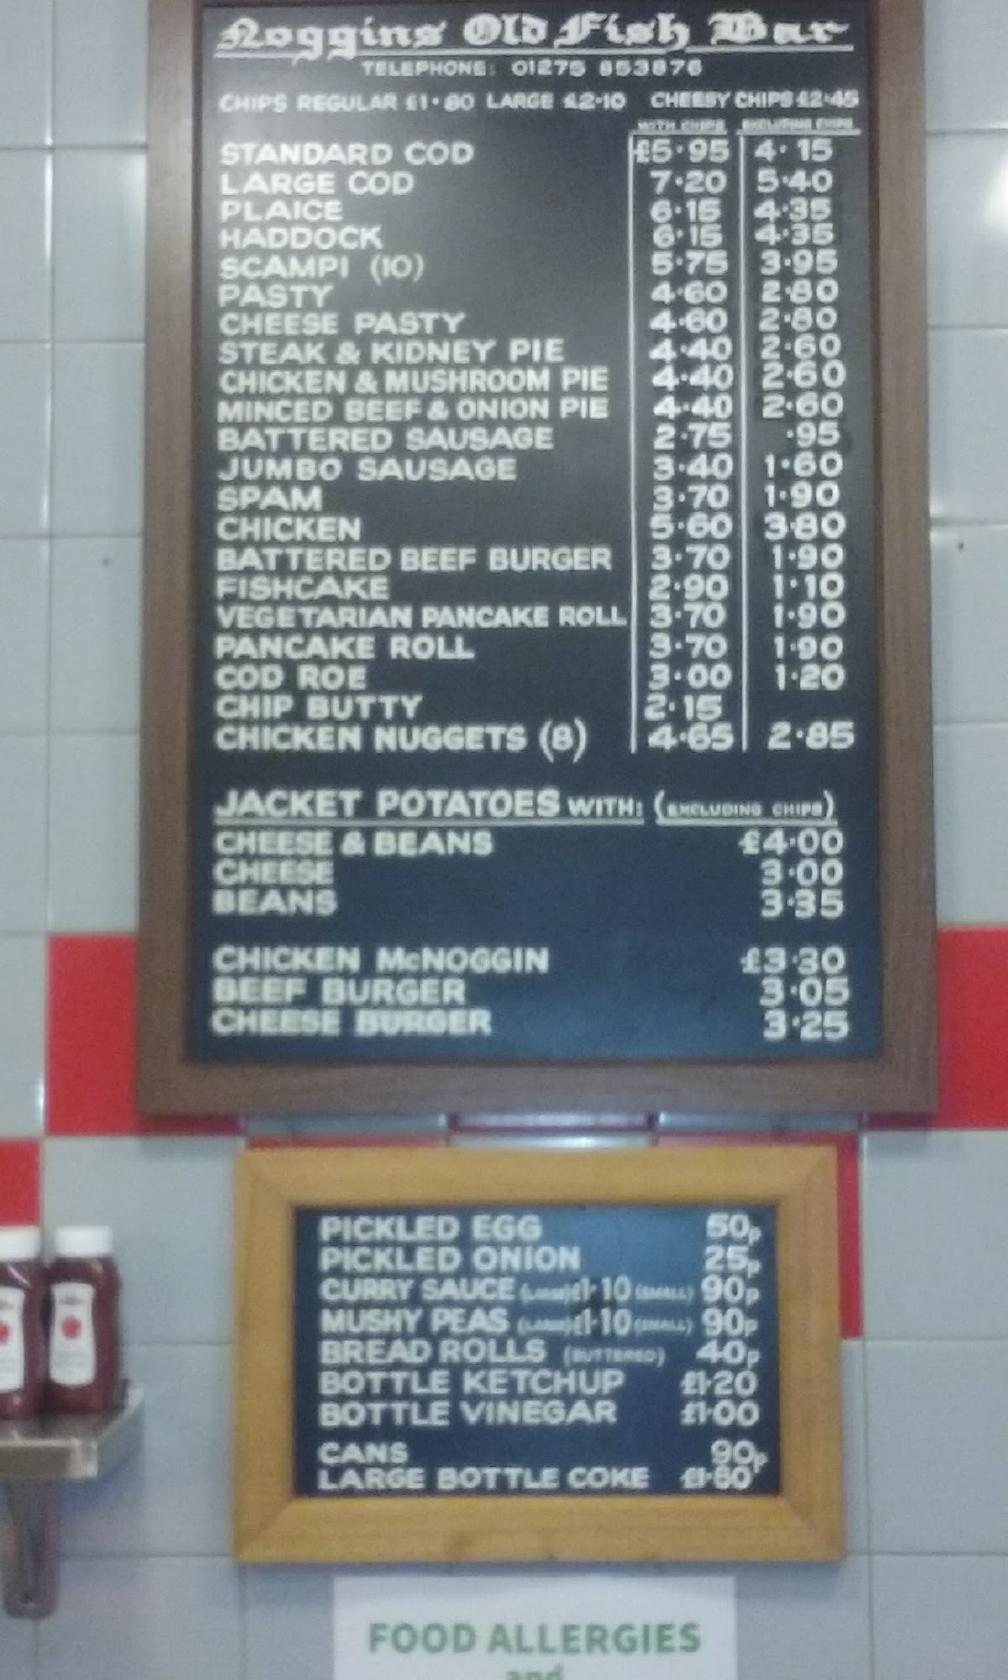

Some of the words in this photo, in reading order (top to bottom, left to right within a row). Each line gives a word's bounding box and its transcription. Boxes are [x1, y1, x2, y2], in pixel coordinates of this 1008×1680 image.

[216, 18, 447, 66] Noggins
[463, 14, 548, 45] Old
[554, 12, 690, 50] Fish
[709, 12, 848, 44] Bar
[219, 94, 287, 112] CHIPS
[296, 93, 397, 112] REGULAR
[487, 92, 553, 109] LARGE
[651, 91, 731, 108] CHEESY
[734, 91, 793, 108] CHIPS
[220, 141, 392, 165] STANDARD
[404, 141, 474, 165] COD
[221, 172, 334, 195] LARGE
[348, 170, 413, 195] COD
[221, 199, 342, 221] PLAICE
[220, 225, 382, 249] HADDOCK
[221, 255, 348, 279] SCAMPI
[370, 253, 425, 284] (10)
[219, 283, 333, 308] PASTY
[220, 312, 338, 335] CHEESE
[355, 312, 465, 334] PASTY
[219, 341, 325, 364] STEAK
[336, 341, 360, 364] &
[371, 340, 496, 363] KIDNEY
[510, 339, 563, 362] PIE
[220, 370, 346, 393] CHICKEN
[355, 370, 377, 394] &
[385, 369, 550, 392] MUSHROOM
[562, 367, 607, 391] PIE
[218, 399, 333, 422] MINCED
[345, 399, 421, 422] BEEF
[427, 400, 449, 420] &
[457, 398, 549, 419] ONION
[560, 397, 608, 419] PIE
[218, 427, 392, 452] BATTERED
[406, 427, 553, 450] SAUSAGE
[219, 458, 342, 480] JUMBO
[358, 457, 516, 481] SAUSAGE
[218, 486, 322, 511] SPAM
[218, 516, 360, 541] CHICKEN
[217, 547, 391, 571] BATTERED
[401, 548, 476, 571] BEEF
[489, 547, 611, 571] BURGER
[217, 576, 388, 600] FISHCAKE
[217, 606, 412, 628] VEGETARIAN
[422, 606, 548, 628] PANCAKE
[559, 606, 627, 626] ROLL
[216, 635, 374, 659] PANCAKE
[390, 634, 475, 659] ROLL
[216, 664, 284, 690] COD
[298, 664, 366, 690] ROE
[216, 694, 293, 719] CHIP
[307, 695, 422, 719] BUTTY
[217, 725, 361, 750] CHICKEN
[375, 726, 527, 751] NUGGETS
[538, 717, 589, 764] (8)
[216, 790, 361, 817] JACKET
[378, 790, 560, 817] POTATOES
[216, 831, 332, 855] CHEESE
[341, 831, 365, 855] &
[374, 830, 493, 856] BEANS
[214, 859, 333, 885] CHEESE
[213, 889, 337, 915] BEANS
[214, 947, 360, 972] CHICKEN
[377, 947, 548, 973] McNOGGIN
[214, 977, 306, 1004] BEEF
[322, 978, 465, 1005] BURGER
[212, 1008, 340, 1035] CHEESE
[356, 1009, 491, 1035] BURGER
[321, 1216, 460, 1242] PICKLED
[472, 1215, 542, 1242] EGG
[321, 1247, 462, 1272] PICKLED
[473, 1246, 580, 1271] ONION
[321, 1278, 414, 1301] CURRY
[422, 1277, 515, 1300] SAUCE
[322, 1309, 422, 1333] MUSHY
[432, 1307, 509, 1334] PEAS
[321, 1339, 431, 1364] BREAD
[438, 1338, 548, 1363] ROLLS
[320, 1370, 450, 1395] BOTTLE
[464, 1368, 624, 1394] KETCHUP
[319, 1400, 450, 1426] BOTTLE
[461, 1400, 616, 1424] VINEGAR
[319, 1442, 408, 1464] CANS
[319, 1468, 424, 1489] LARGE
[438, 1467, 559, 1489] BOTTLE
[568, 1467, 648, 1488] COKE
[369, 1623, 476, 1653] FOOD
[488, 1624, 701, 1654] ALLERGIES
